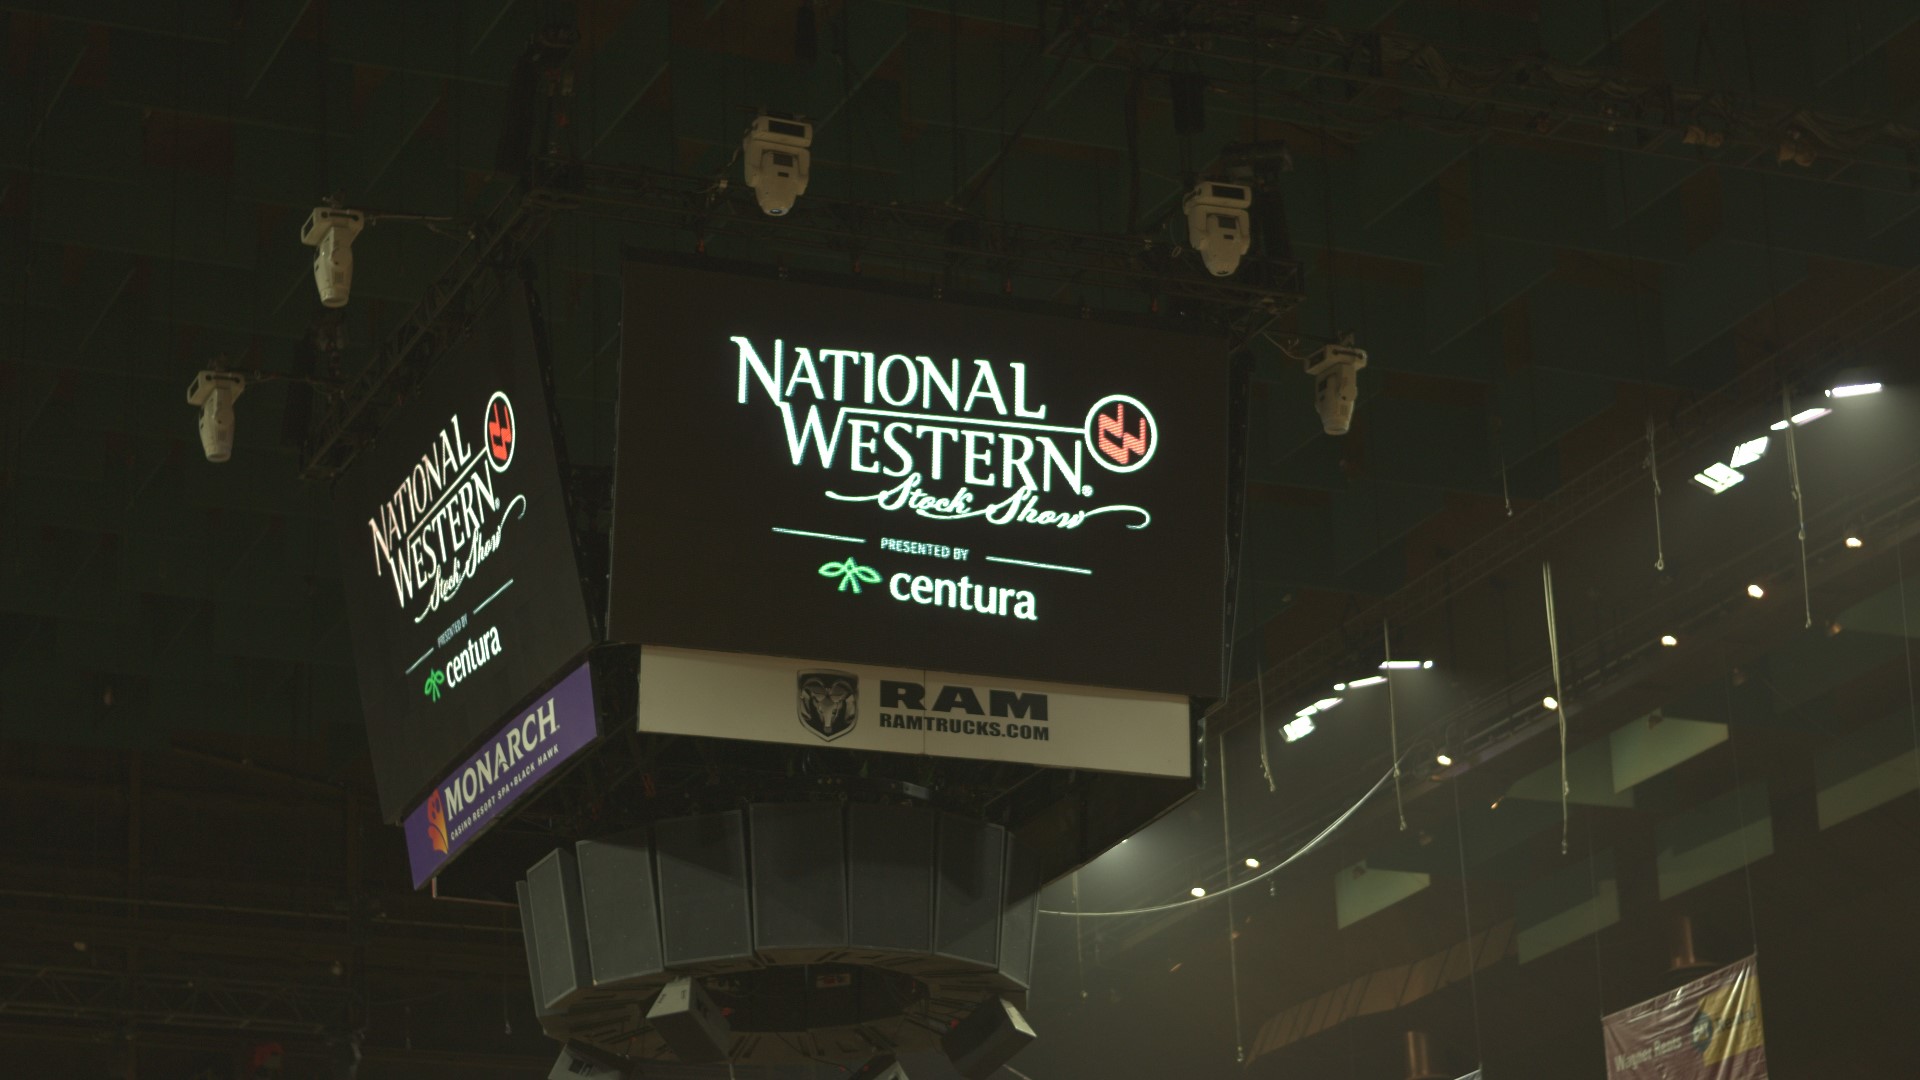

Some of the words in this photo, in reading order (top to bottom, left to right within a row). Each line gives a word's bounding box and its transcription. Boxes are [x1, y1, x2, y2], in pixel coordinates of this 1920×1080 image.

[730, 336, 1046, 420] NATIONAL
[778, 400, 1085, 496] WESTERN
[369, 414, 471, 576] NATIONAL
[877, 472, 971, 517] Stock
[985, 485, 1086, 529] Show
[389, 459, 497, 608] WESTERN
[464, 526, 502, 579] Show
[881, 537, 950, 559] PRESENTED
[953, 547, 969, 561] BY
[460, 612, 469, 629] BY
[889, 571, 1038, 621] centura
[446, 626, 502, 688] centura
[880, 680, 1048, 721] RAM
[880, 713, 1049, 741] RAMTRUCKS.COM
[444, 697, 559, 821] MONARCH
[450, 818, 472, 841] CASINO
[472, 795, 496, 821] RESORT
[497, 782, 510, 800] SPA
[513, 762, 535, 786] BLACK
[537, 743, 560, 767] HAWK
